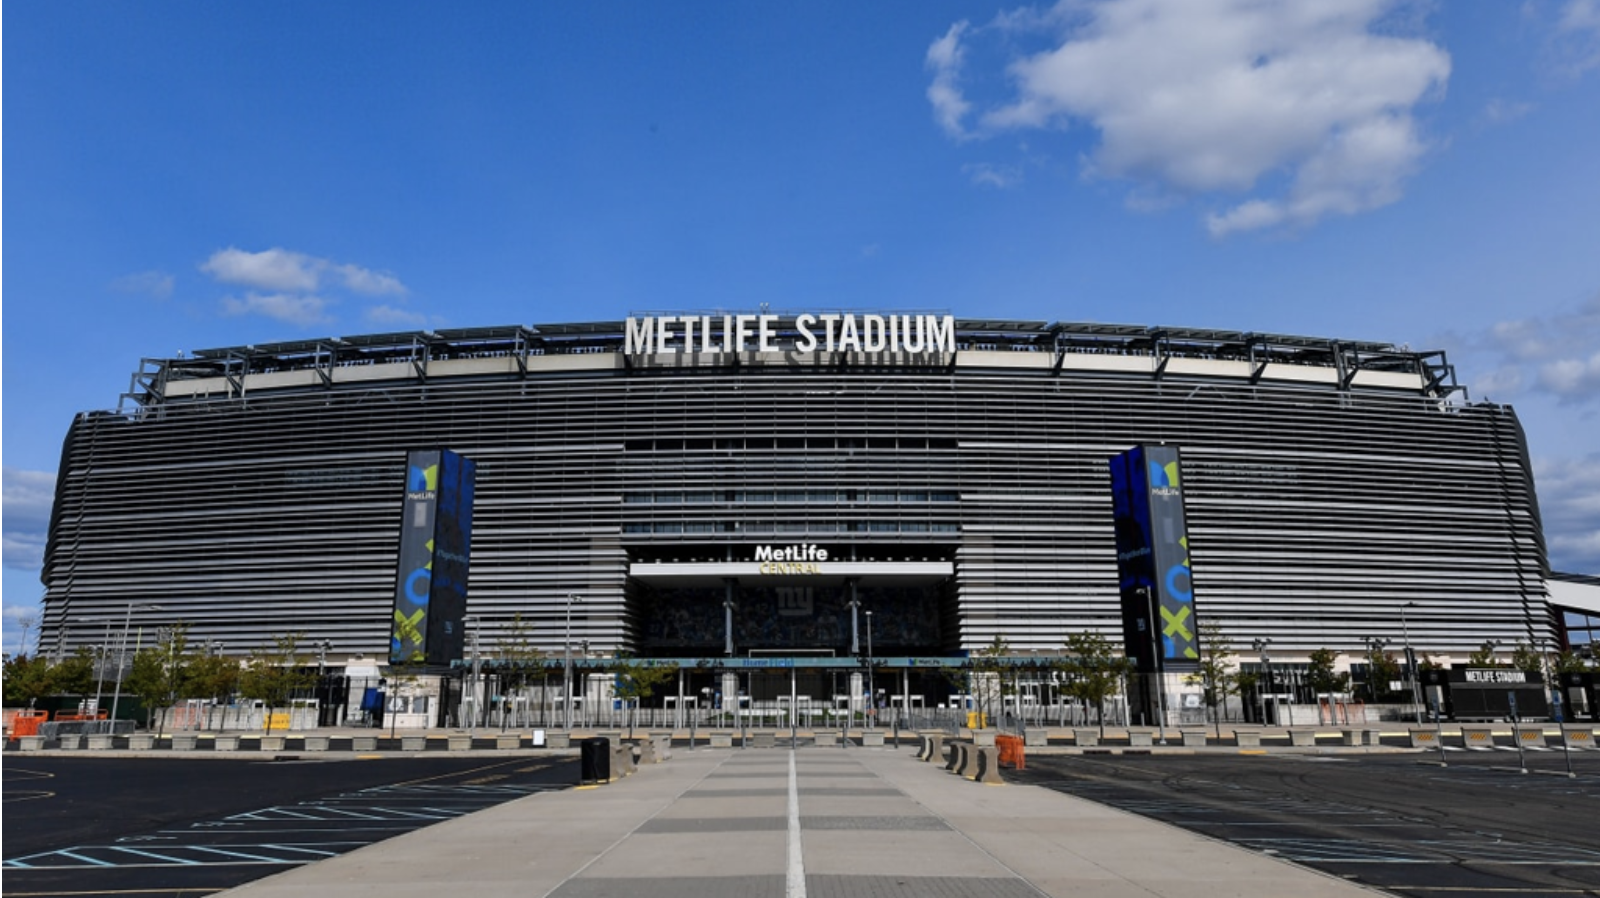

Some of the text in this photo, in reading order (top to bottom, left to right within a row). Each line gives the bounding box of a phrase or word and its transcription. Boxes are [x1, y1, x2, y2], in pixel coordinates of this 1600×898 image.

[625, 314, 956, 354] METLIFE STADIUM
[407, 491, 436, 501] MetLife
[755, 543, 828, 561] MetLife
[760, 561, 822, 575] CENTRAL
[1465, 671, 1526, 683] METLIFE STADIUM
